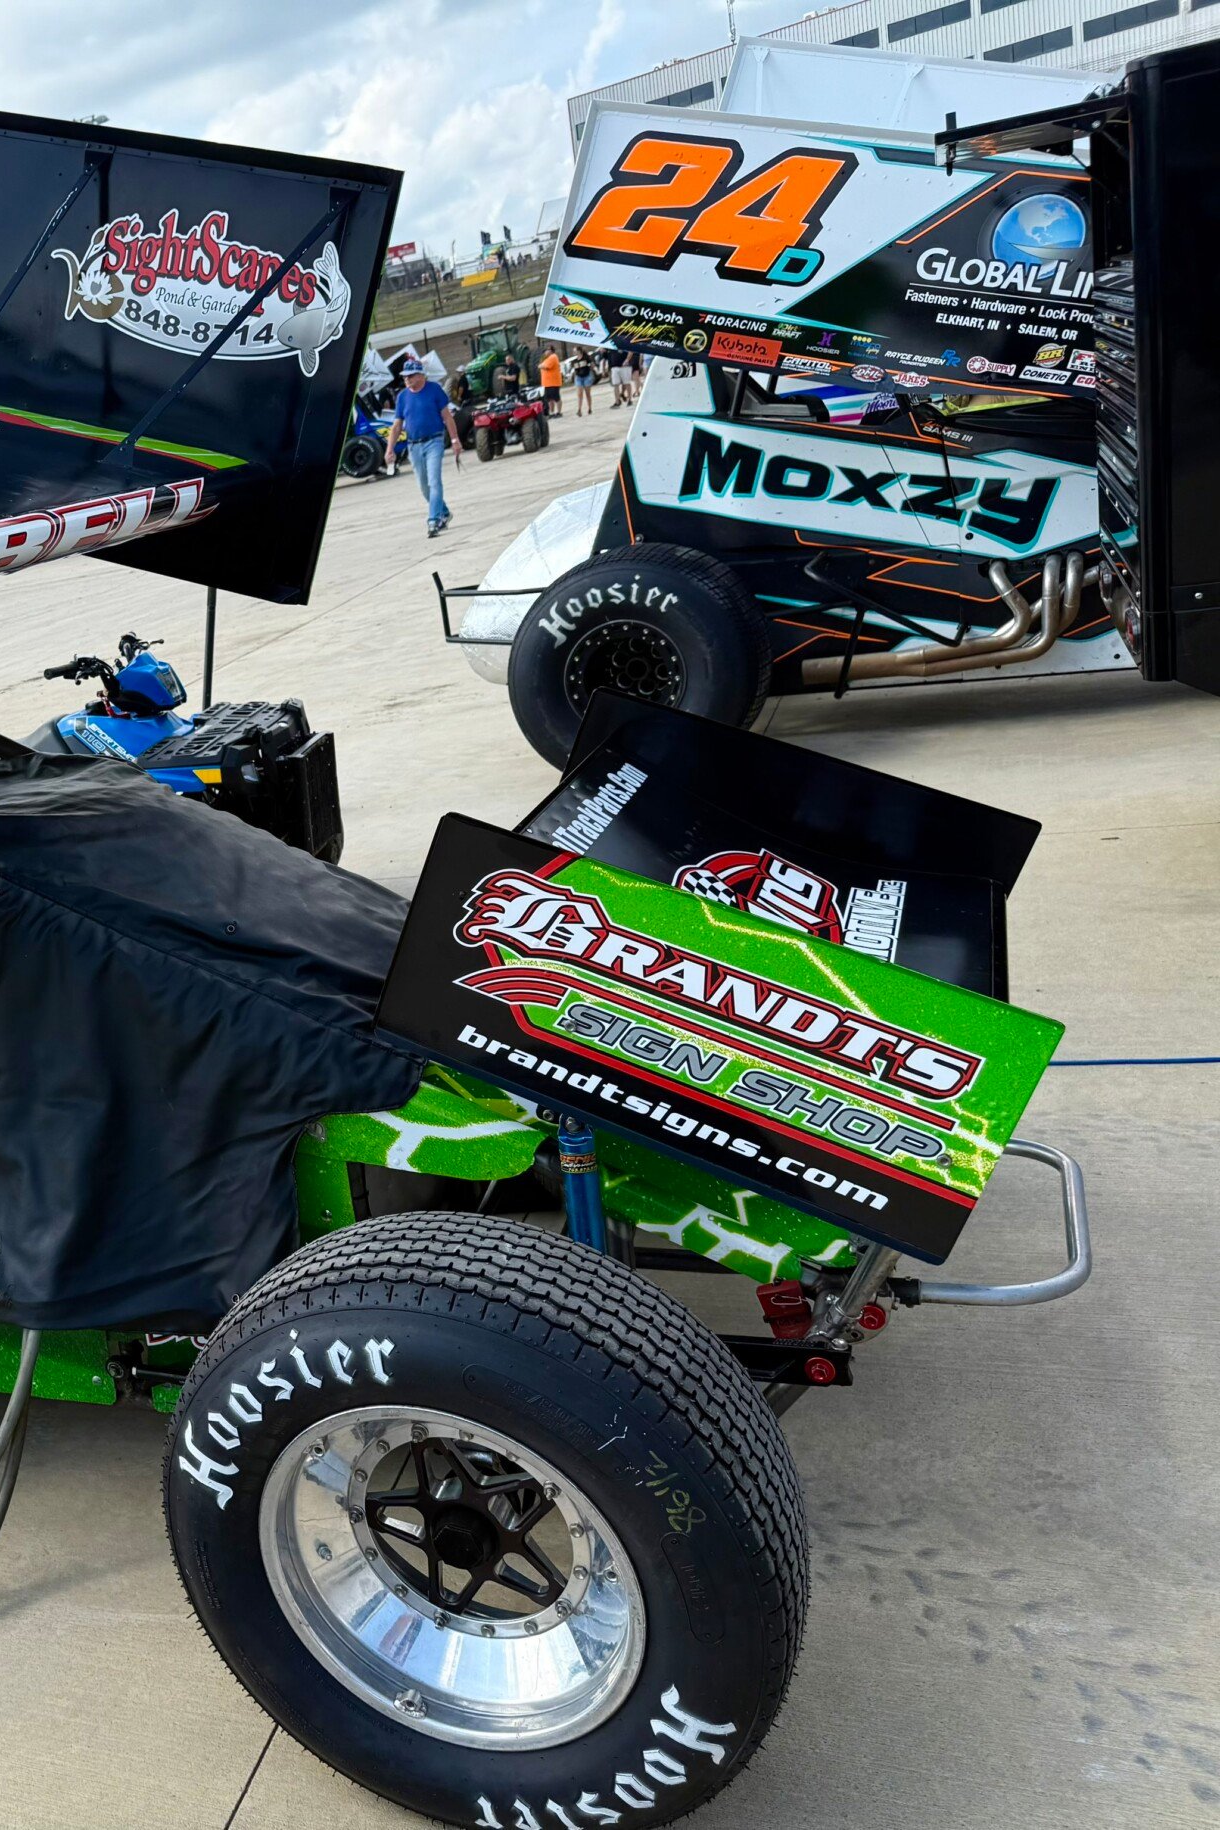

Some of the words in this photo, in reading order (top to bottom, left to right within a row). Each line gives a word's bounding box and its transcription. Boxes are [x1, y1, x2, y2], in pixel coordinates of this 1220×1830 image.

[916, 247, 1042, 293] GLOBAL
[155, 286, 186, 306] Pond
[904, 289, 960, 307] Fasteners
[970, 297, 1027, 315] Hardware
[1038, 305, 1068, 320] Lock
[555, 305, 599, 320] SUNOCO
[640, 307, 684, 325] Kubota
[548, 325, 570, 334] RACE
[570, 329, 596, 338] FUELS
[936, 313, 985, 331] ELKHART,
[986, 319, 1000, 331] IN
[1018, 324, 1059, 341] SALEM,
[1061, 329, 1079, 341] OR
[650, 340, 676, 348] RACING
[717, 336, 767, 356] Kubota
[783, 356, 833, 370] CAPITOL
[884, 350, 913, 361] RAYCE
[913, 355, 947, 366] RUDEEN
[987, 363, 1015, 374] SUPPLY
[537, 573, 679, 649] Hoosier
[458, 868, 985, 1098] BRANDT'S
[565, 1001, 729, 1086] SIGN
[733, 1065, 950, 1166] SHOP
[457, 1024, 890, 1212] brandtsigns.com
[179, 1329, 397, 1511] Hoosier
